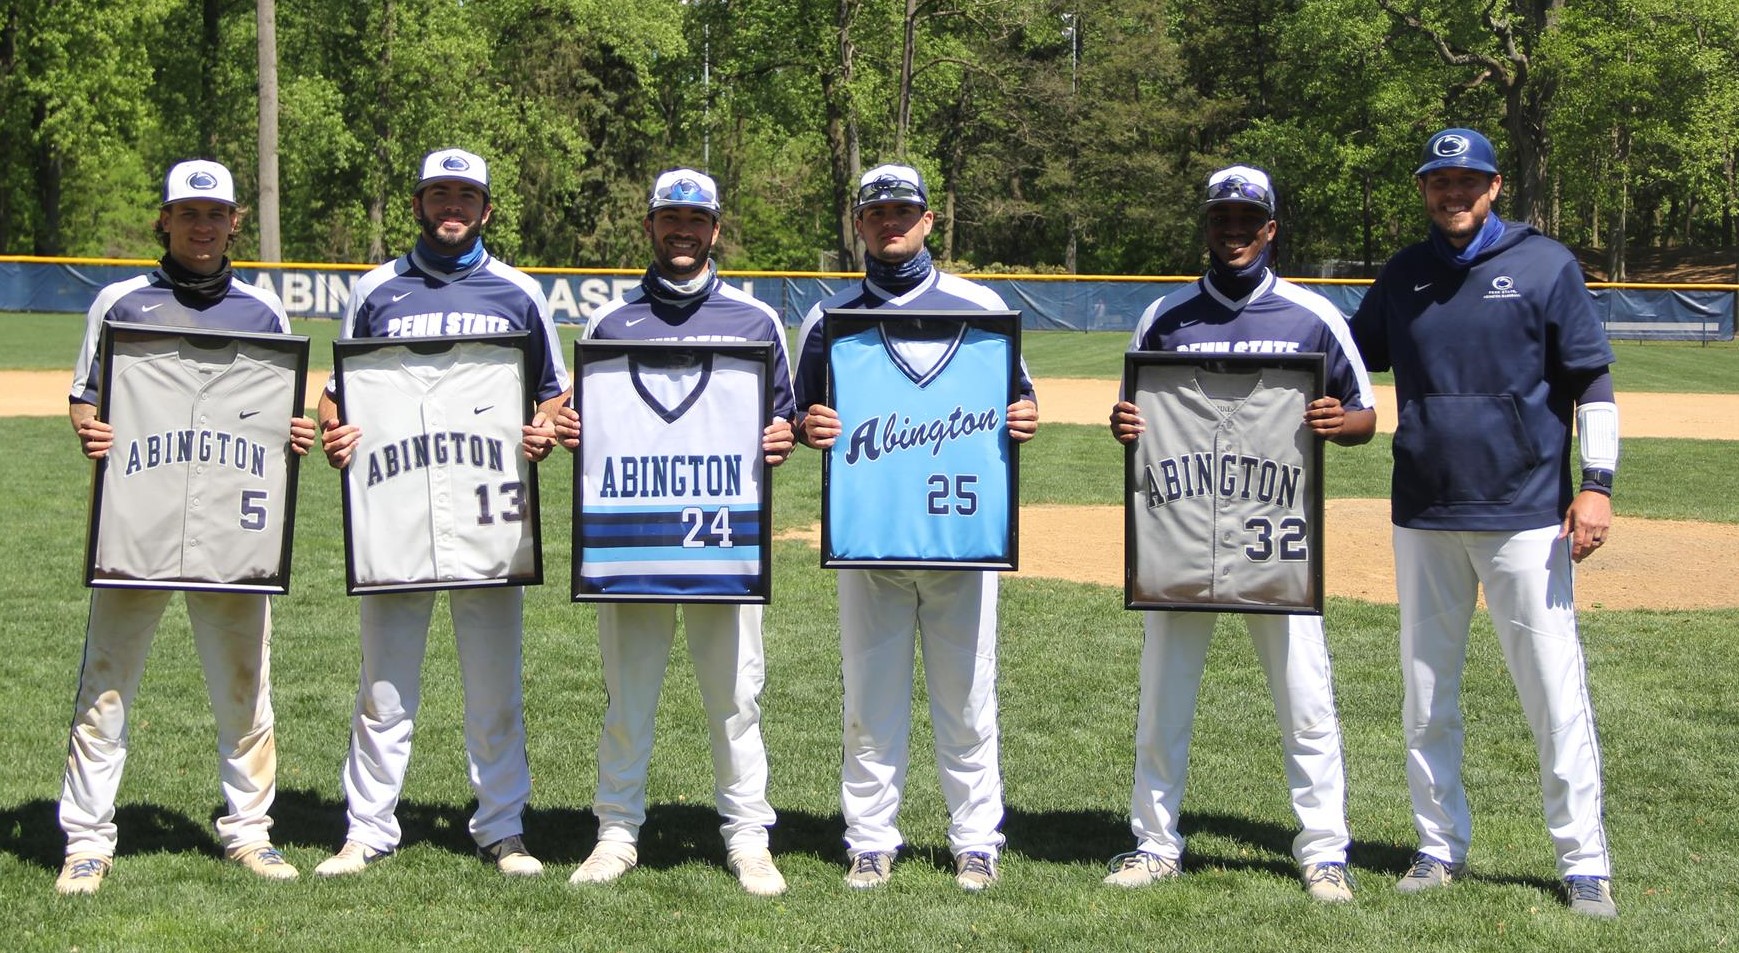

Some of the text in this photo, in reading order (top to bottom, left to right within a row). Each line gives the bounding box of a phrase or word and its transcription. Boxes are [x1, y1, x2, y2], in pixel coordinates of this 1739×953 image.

[388, 311, 510, 338] PENN STATE
[125, 428, 267, 479] ABINGTON
[845, 406, 999, 465] Abington
[366, 431, 506, 489] ABINGTON
[600, 454, 742, 498] ABINGTON
[1146, 452, 1302, 509] ABINGTON
[238, 488, 270, 532] 5
[473, 481, 527, 526] 13
[926, 473, 979, 517] 25
[680, 506, 735, 549] 24
[1243, 515, 1310, 564] 32
